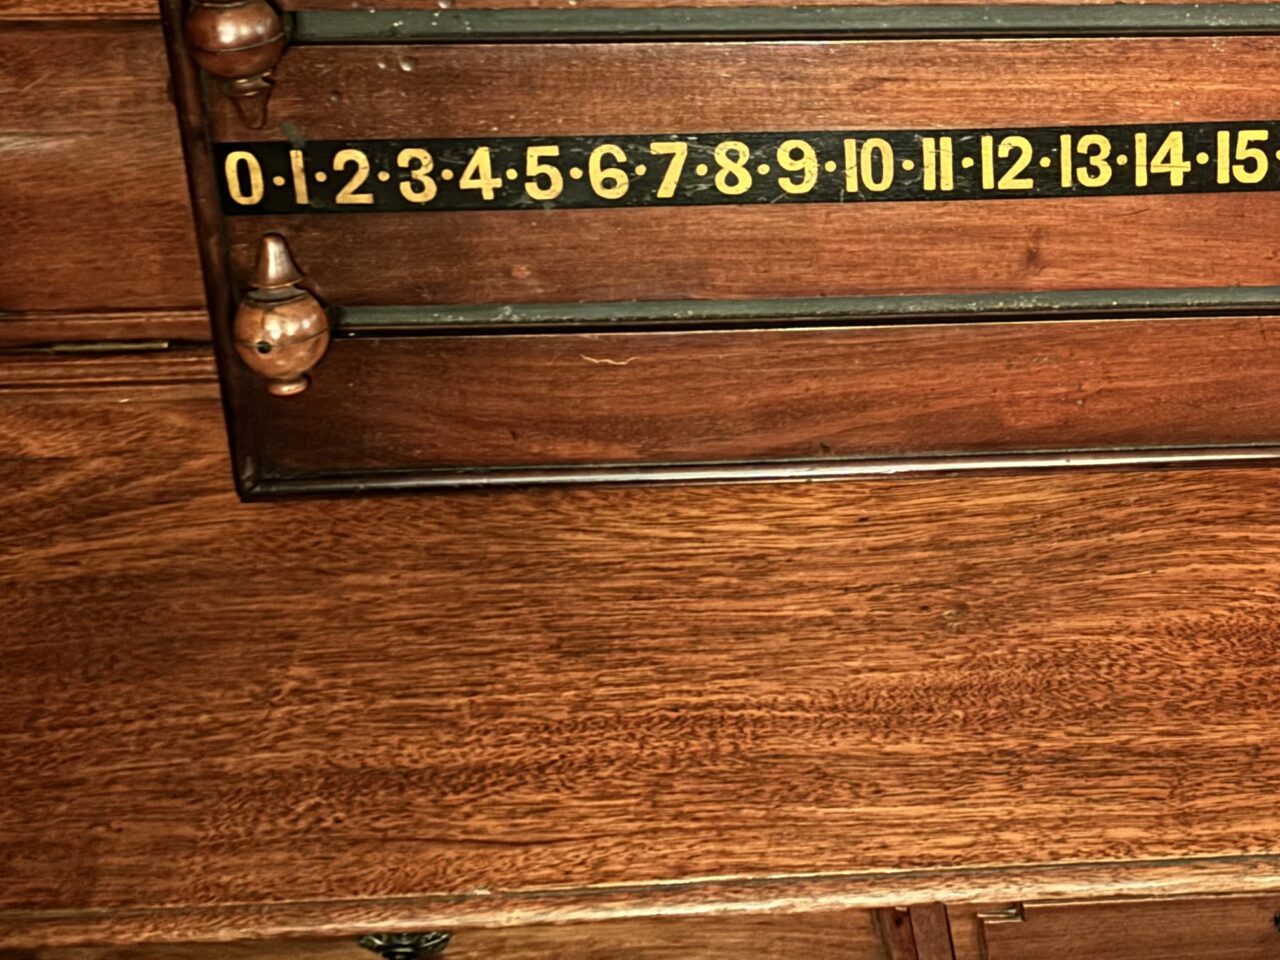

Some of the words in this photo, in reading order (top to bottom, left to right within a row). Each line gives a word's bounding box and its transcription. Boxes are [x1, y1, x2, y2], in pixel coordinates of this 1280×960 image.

[225, 150, 265, 205] 0
[288, 149, 309, 204] 1
[332, 148, 374, 204] 2
[396, 147, 438, 203] 3
[458, 145, 503, 201] 4
[523, 145, 564, 201] 5
[587, 143, 629, 200] 6
[649, 141, 689, 198] 7
[709, 140, 754, 195] 8
[776, 139, 820, 194] 9
[842, 137, 895, 193] 10
[920, 136, 955, 191] 11
[979, 135, 1034, 190] 12
[1058, 134, 1113, 189] 13
[1133, 130, 1192, 188] 14
[1215, 129, 1269, 185] 15
